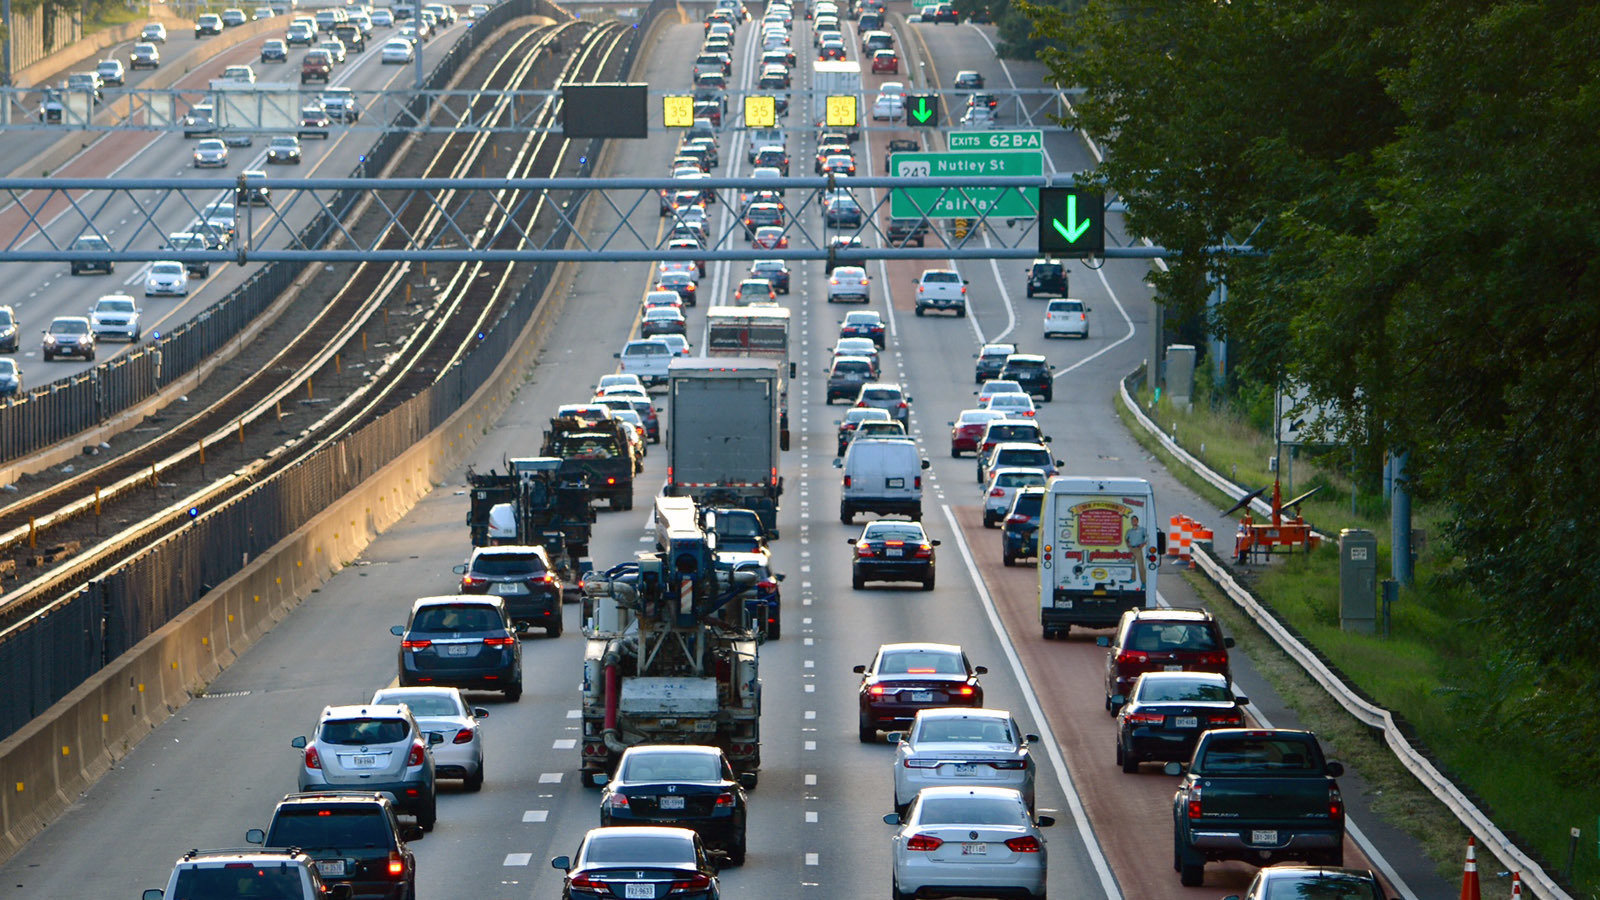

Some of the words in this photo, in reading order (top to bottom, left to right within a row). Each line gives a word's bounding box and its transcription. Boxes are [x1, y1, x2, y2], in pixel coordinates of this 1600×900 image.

[671, 105, 687, 117] 35
[751, 105, 768, 117] 35
[832, 105, 849, 117] 35
[951, 137, 980, 146] EXITS
[902, 167, 927, 177] 243
[938, 160, 985, 172] Nutley
[990, 160, 1005, 170] St
